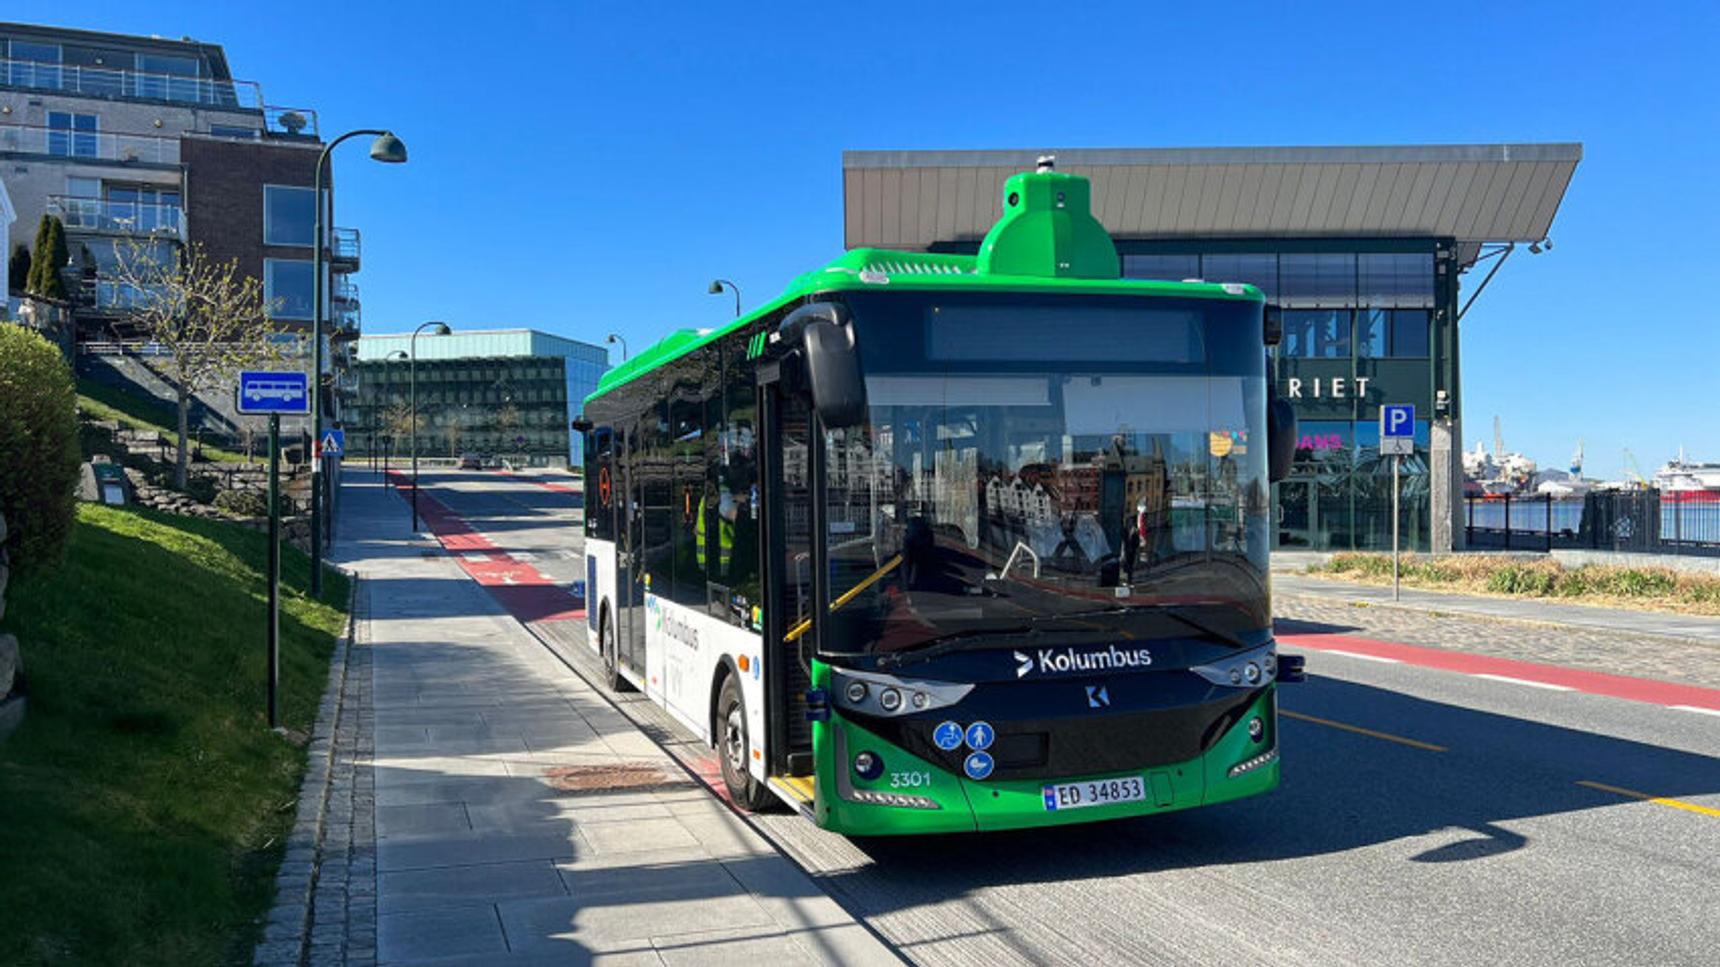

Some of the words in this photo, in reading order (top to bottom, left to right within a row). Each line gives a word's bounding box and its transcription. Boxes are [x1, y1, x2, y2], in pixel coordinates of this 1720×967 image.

[1288, 377, 1370, 398] RIET
[1391, 409, 1407, 433] P
[1295, 434, 1342, 449] ANS
[1038, 644, 1152, 673] Kolumbus
[890, 770, 931, 788] 3301
[1058, 785, 1081, 806] ED
[1088, 779, 1141, 803] 34853
